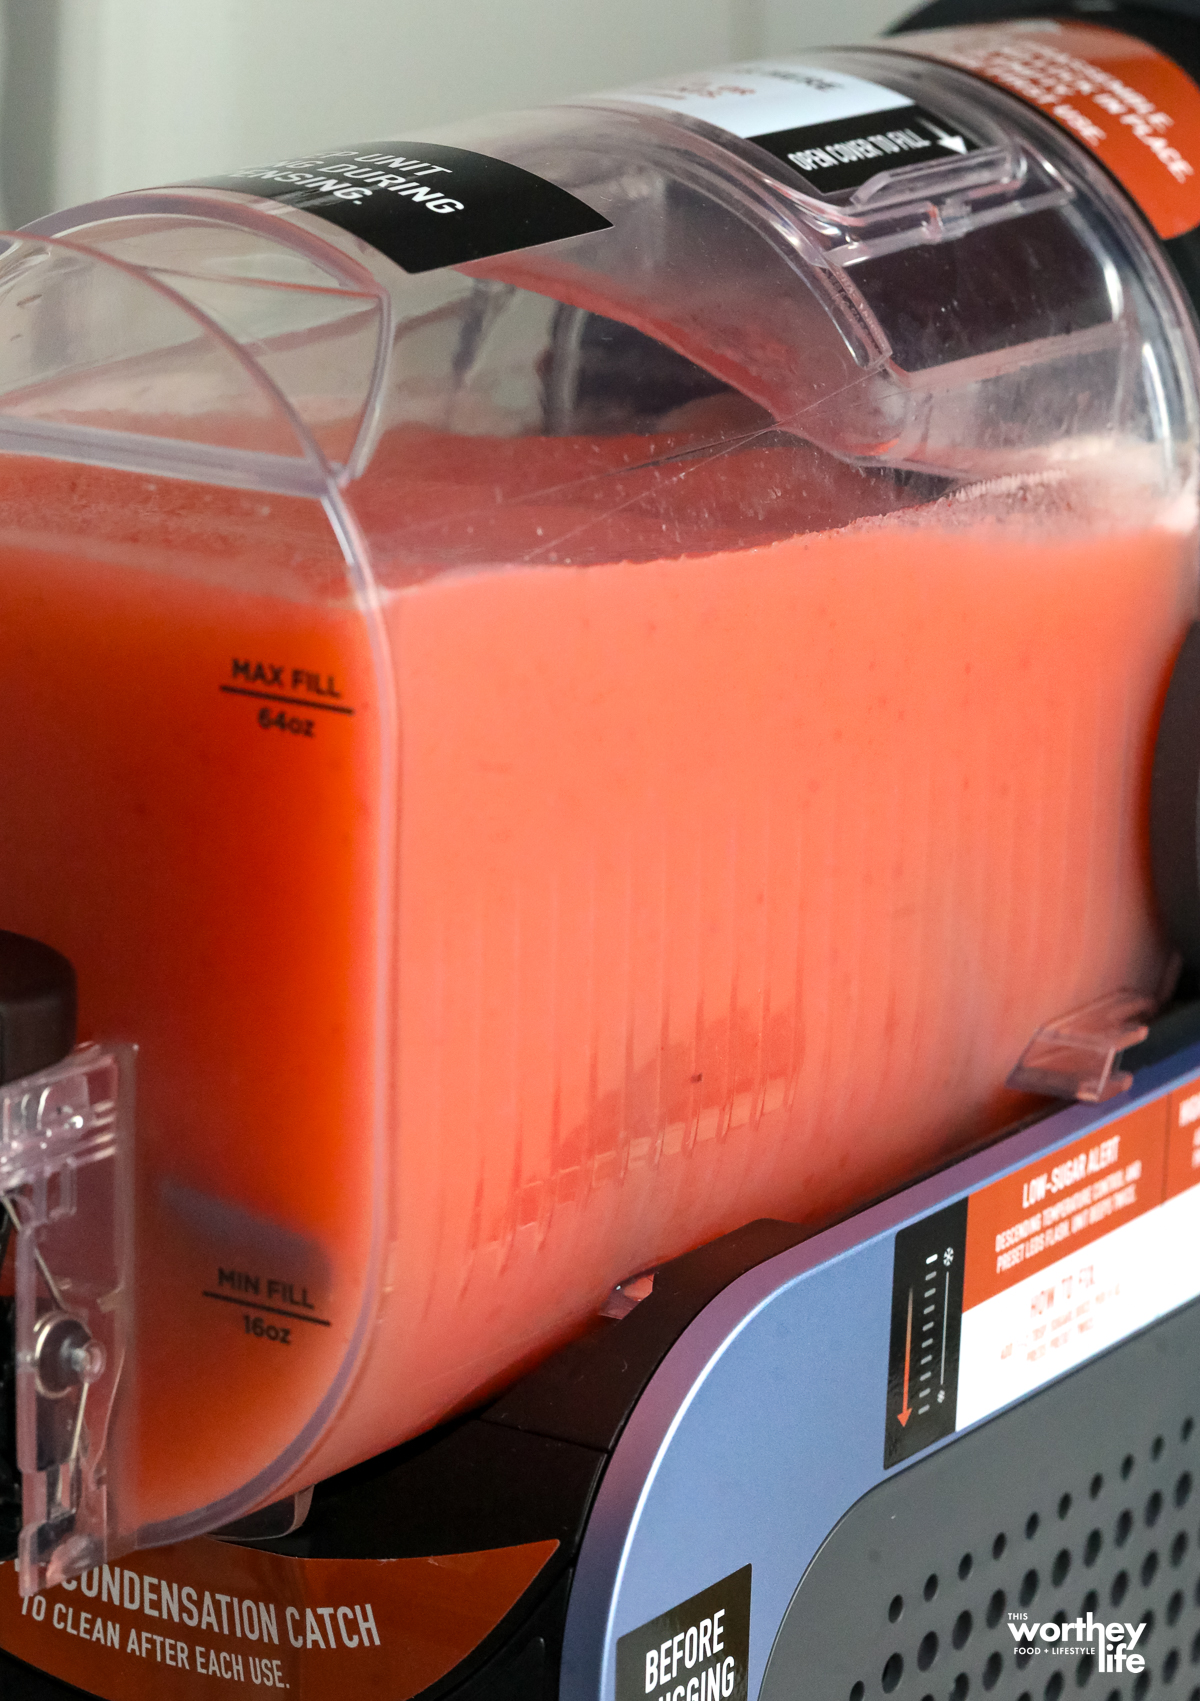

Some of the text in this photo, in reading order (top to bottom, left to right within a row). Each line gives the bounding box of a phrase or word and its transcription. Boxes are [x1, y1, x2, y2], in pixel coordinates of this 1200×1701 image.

[354, 153, 453, 176] UNIT
[787, 147, 839, 171] OPEN
[824, 138, 884, 163] COVER
[315, 163, 465, 214] DURING
[232, 659, 341, 698] MAX FILL
[258, 708, 315, 737] 64oz
[1022, 1152, 1087, 1210] LOW-SUGAR
[1087, 1135, 1121, 1176] ALERT
[218, 1267, 315, 1310] MIN FILL
[243, 1314, 291, 1346] 16oz
[53, 1603, 120, 1650] CLEAN
[126, 1628, 190, 1669] AFTER
[196, 1646, 244, 1682] EACH
[249, 1656, 290, 1689] USE.
[287, 1603, 382, 1649] CATCH
[645, 1608, 726, 1694] BEFORE
[658, 1656, 735, 1701] GING
